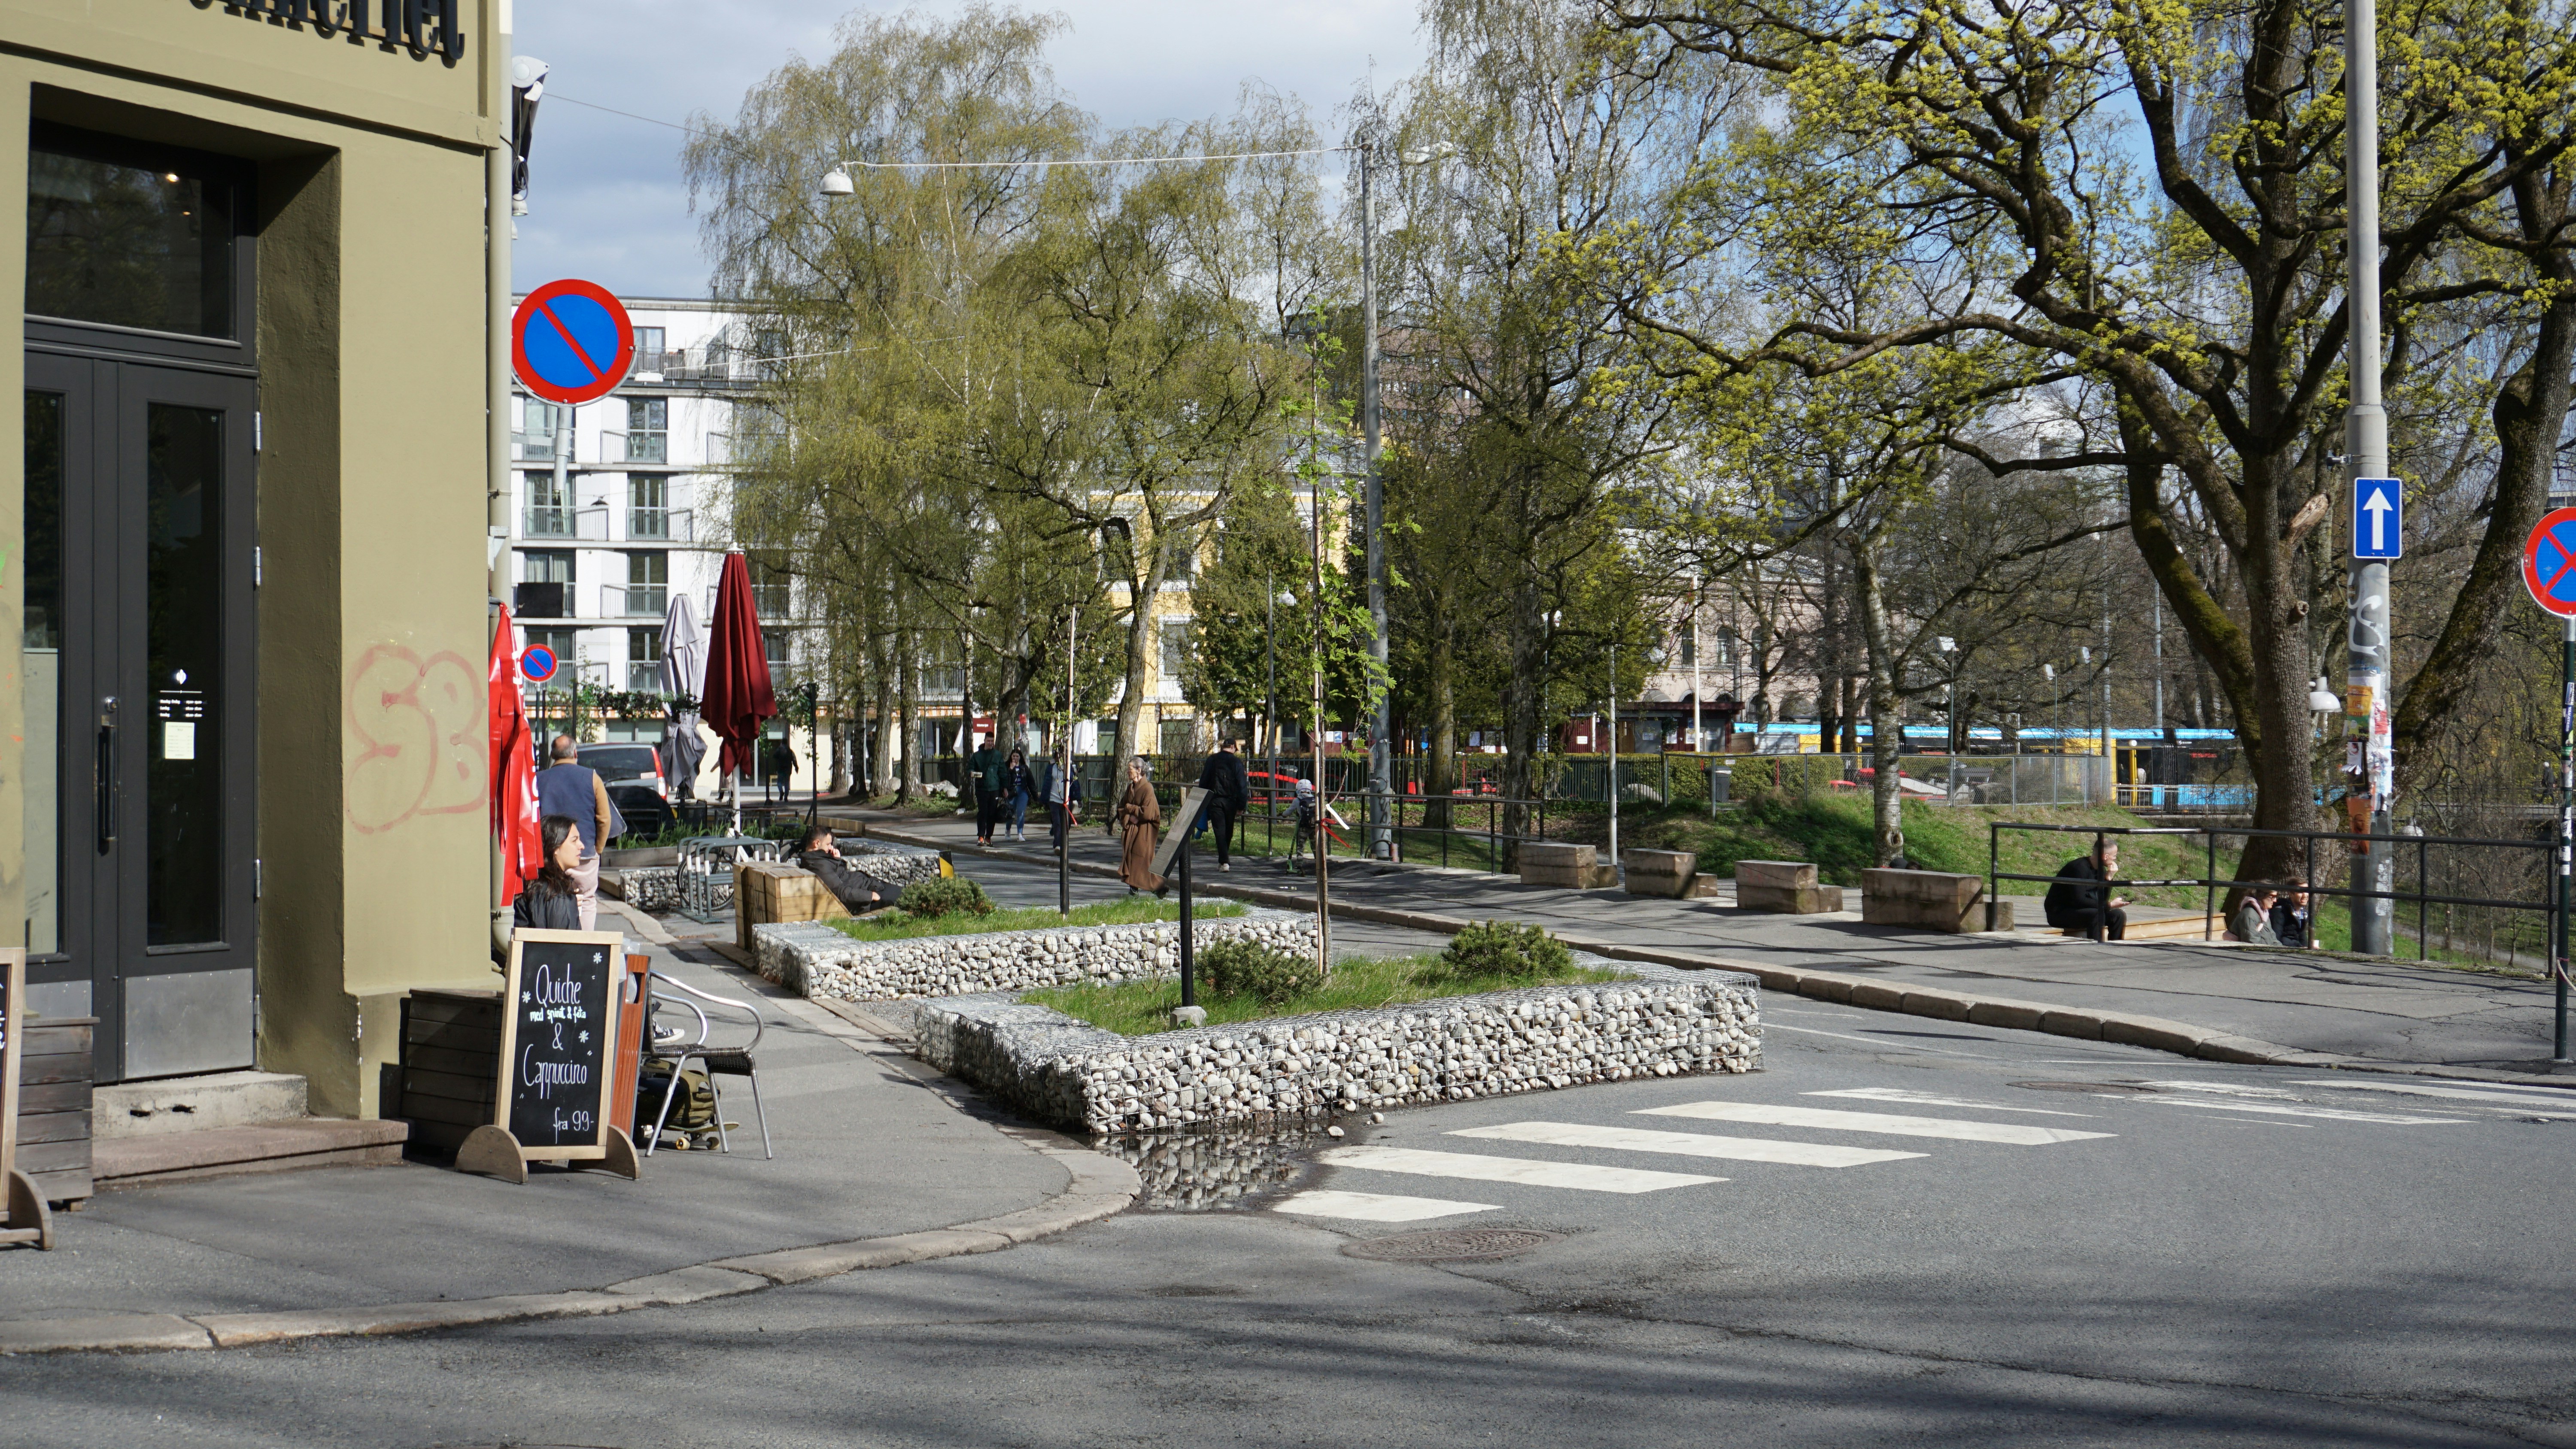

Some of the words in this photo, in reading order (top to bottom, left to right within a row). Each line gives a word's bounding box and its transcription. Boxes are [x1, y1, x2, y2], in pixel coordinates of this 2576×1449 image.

[536, 963, 581, 1007] Quiche
[530, 1009, 544, 1022] med
[567, 1006, 572, 1019] &
[573, 1006, 586, 1023] feta
[552, 1023, 563, 1050] &
[523, 1044, 587, 1099] Cappuccino
[553, 1107, 568, 1144] fra
